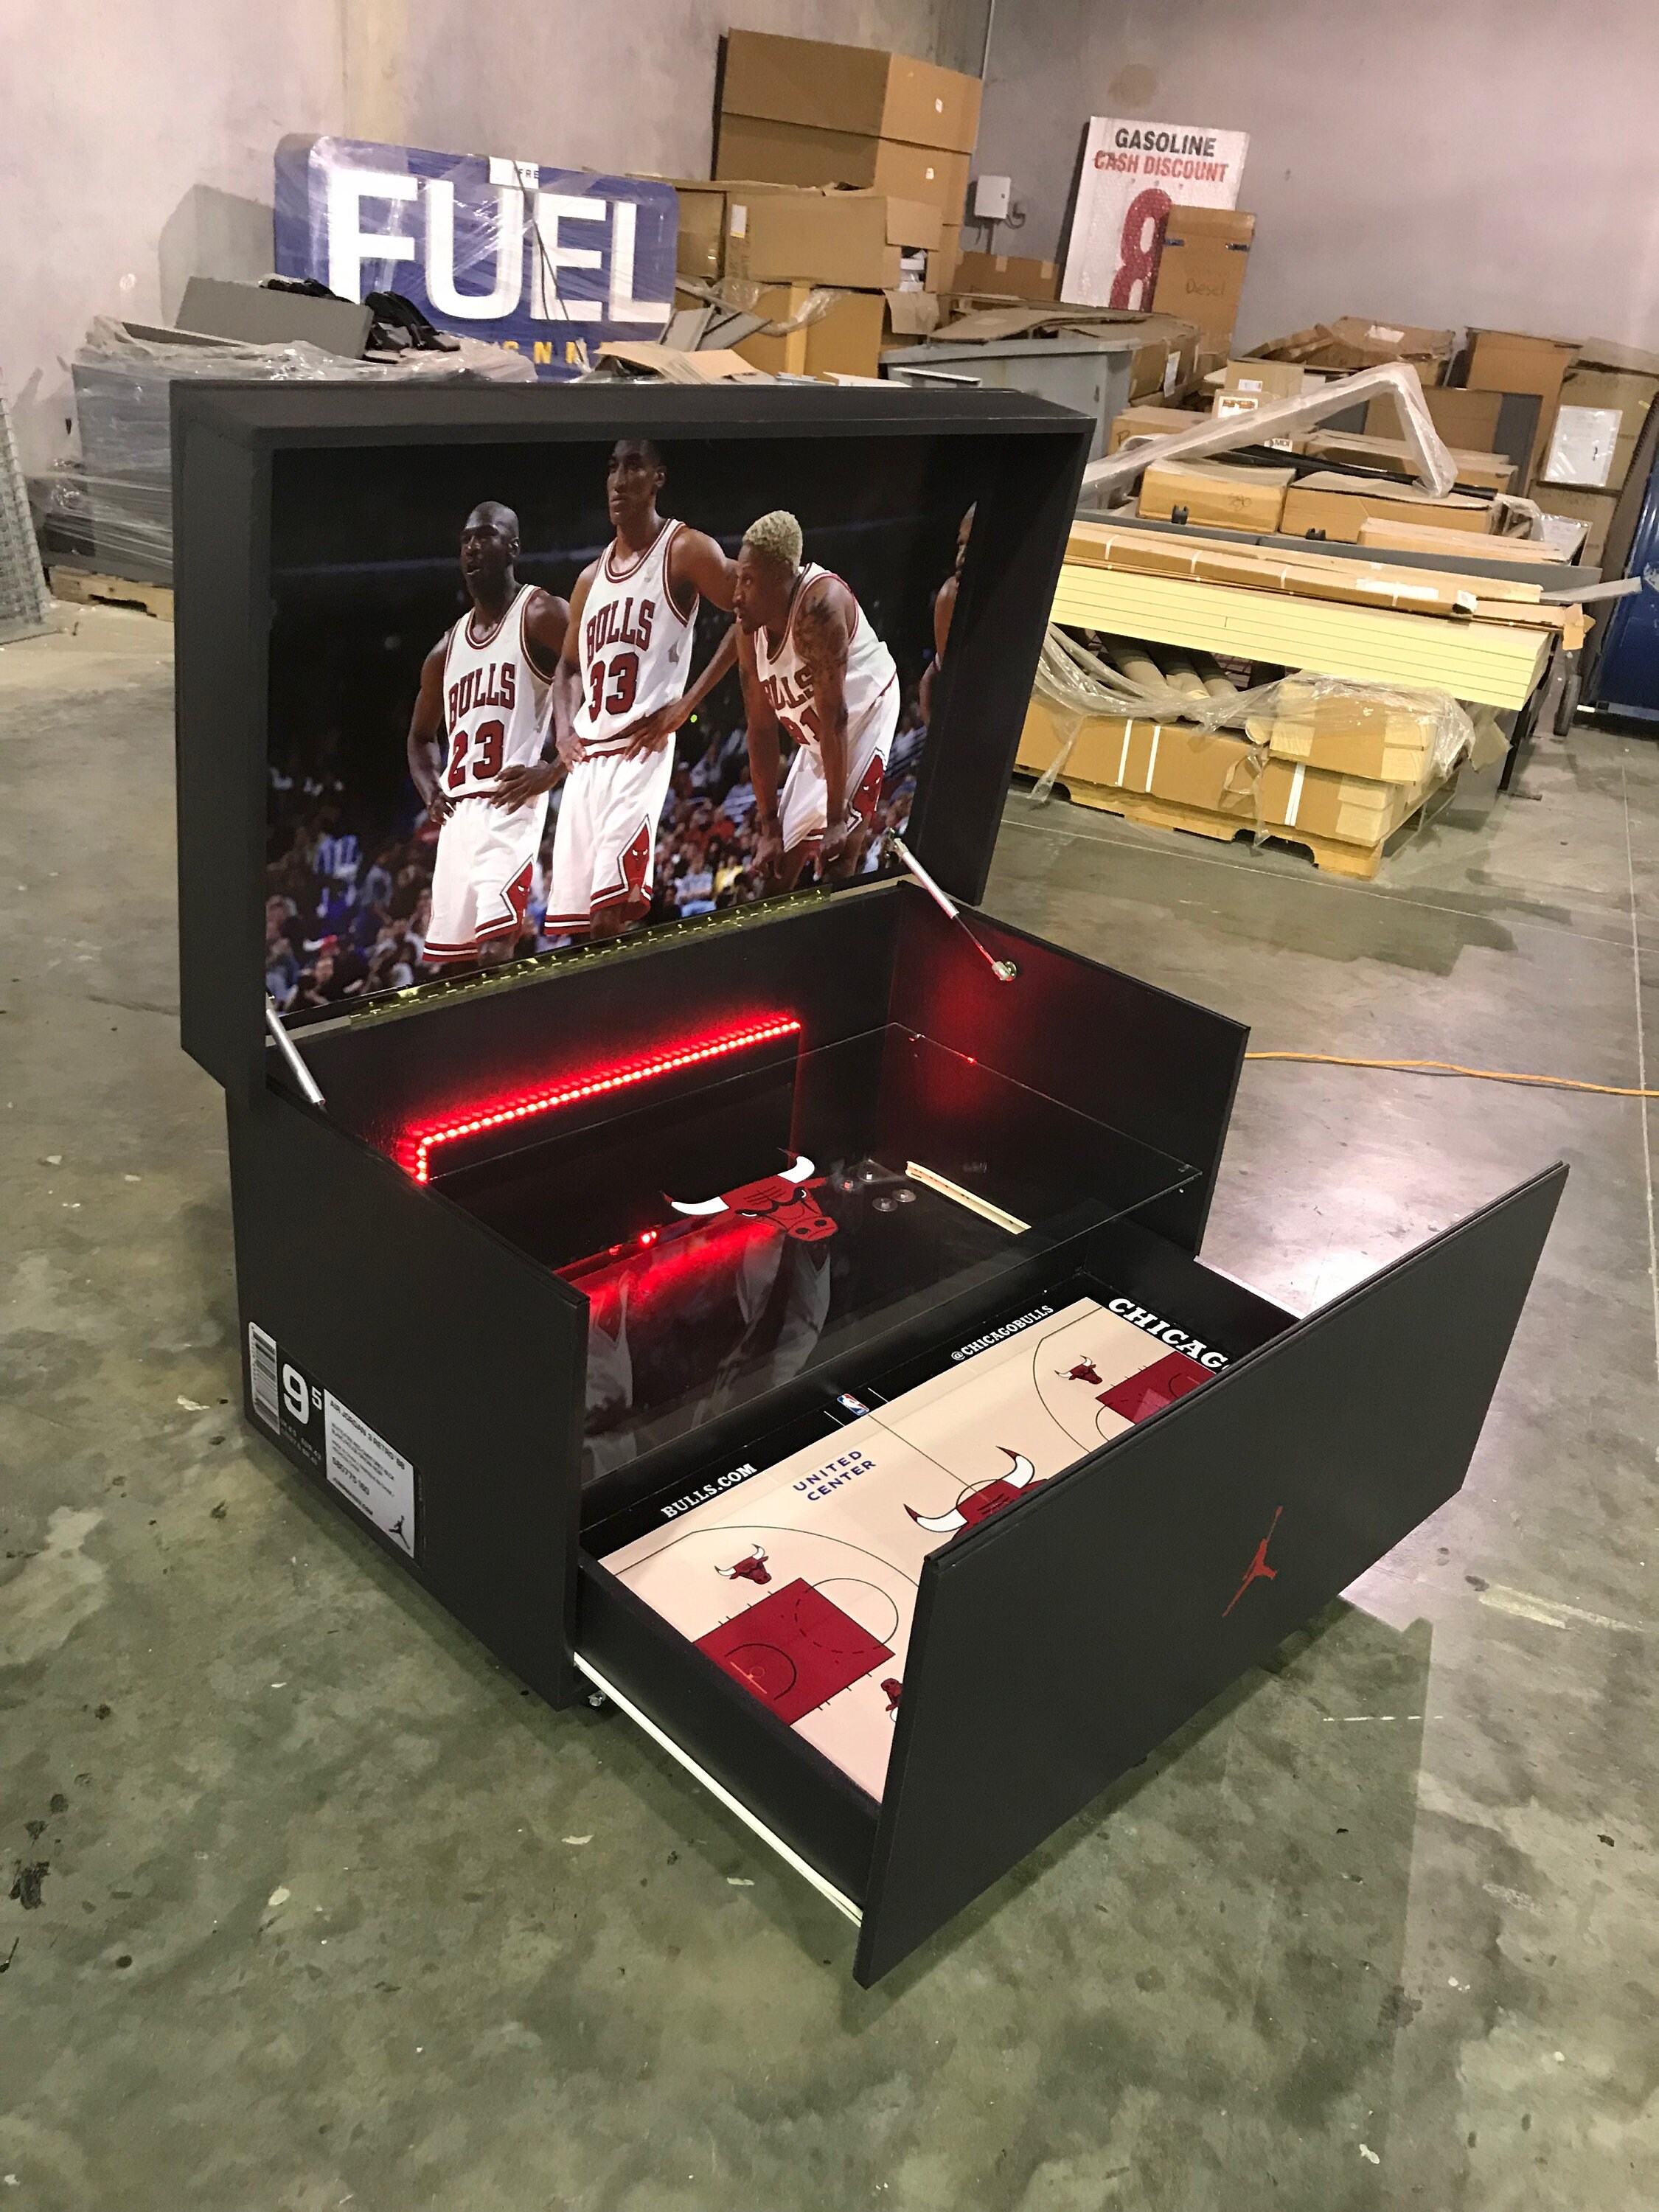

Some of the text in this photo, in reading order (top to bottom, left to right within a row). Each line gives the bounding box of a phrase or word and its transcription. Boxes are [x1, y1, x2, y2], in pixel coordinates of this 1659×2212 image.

[1094, 150, 1229, 182] CASH DISCOUNT
[1115, 128, 1217, 158] GASOLINE
[327, 167, 671, 323] FUEL
[586, 597, 656, 669] BULLS
[448, 661, 516, 737] BULLS
[588, 651, 640, 723] 33
[447, 719, 505, 790] 23
[950, 1304, 1054, 1361] @CHICAGOBULLS
[1107, 1298, 1231, 1370] CHICAG
[282, 1363, 309, 1425] 9
[311, 1385, 322, 1411] 5
[661, 1463, 757, 1518] BULLS.COM
[793, 1450, 863, 1492] UNITED
[807, 1459, 877, 1501] CENTER
